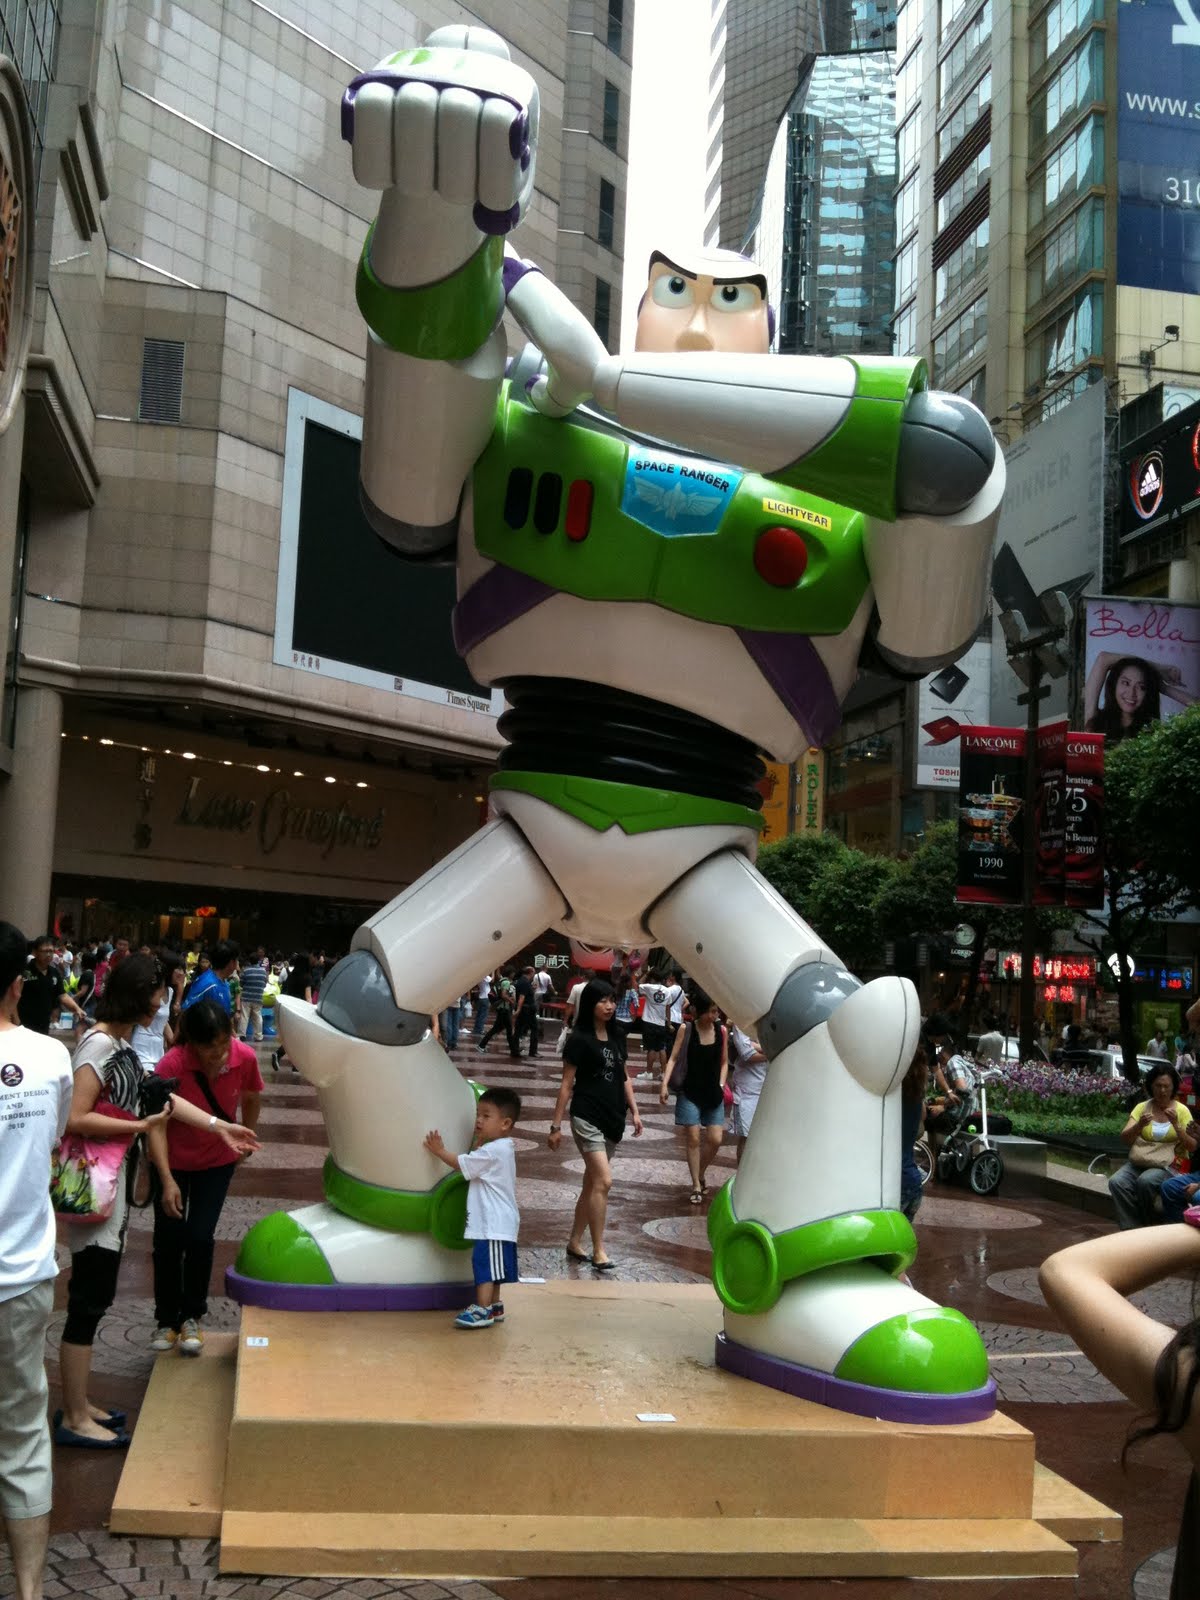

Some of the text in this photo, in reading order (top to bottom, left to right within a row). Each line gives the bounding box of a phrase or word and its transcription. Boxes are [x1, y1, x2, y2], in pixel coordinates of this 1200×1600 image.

[635, 461, 730, 493] SPACE RANGER
[1140, 477, 1160, 497] adidas
[767, 500, 829, 528] LIGHTYEAR
[1089, 605, 1200, 643] Bella
[446, 689, 490, 712] Times Square
[965, 736, 1018, 750] LANCÔME
[806, 764, 819, 828] ROLEX
[1072, 833, 1098, 845] Beauty
[1075, 845, 1095, 855] 2010
[979, 857, 1004, 869] 1990
[23, 1089, 49, 1098] DESIGN
[6, 1102, 23, 1110] AND
[8, 1122, 25, 1130] 2010
